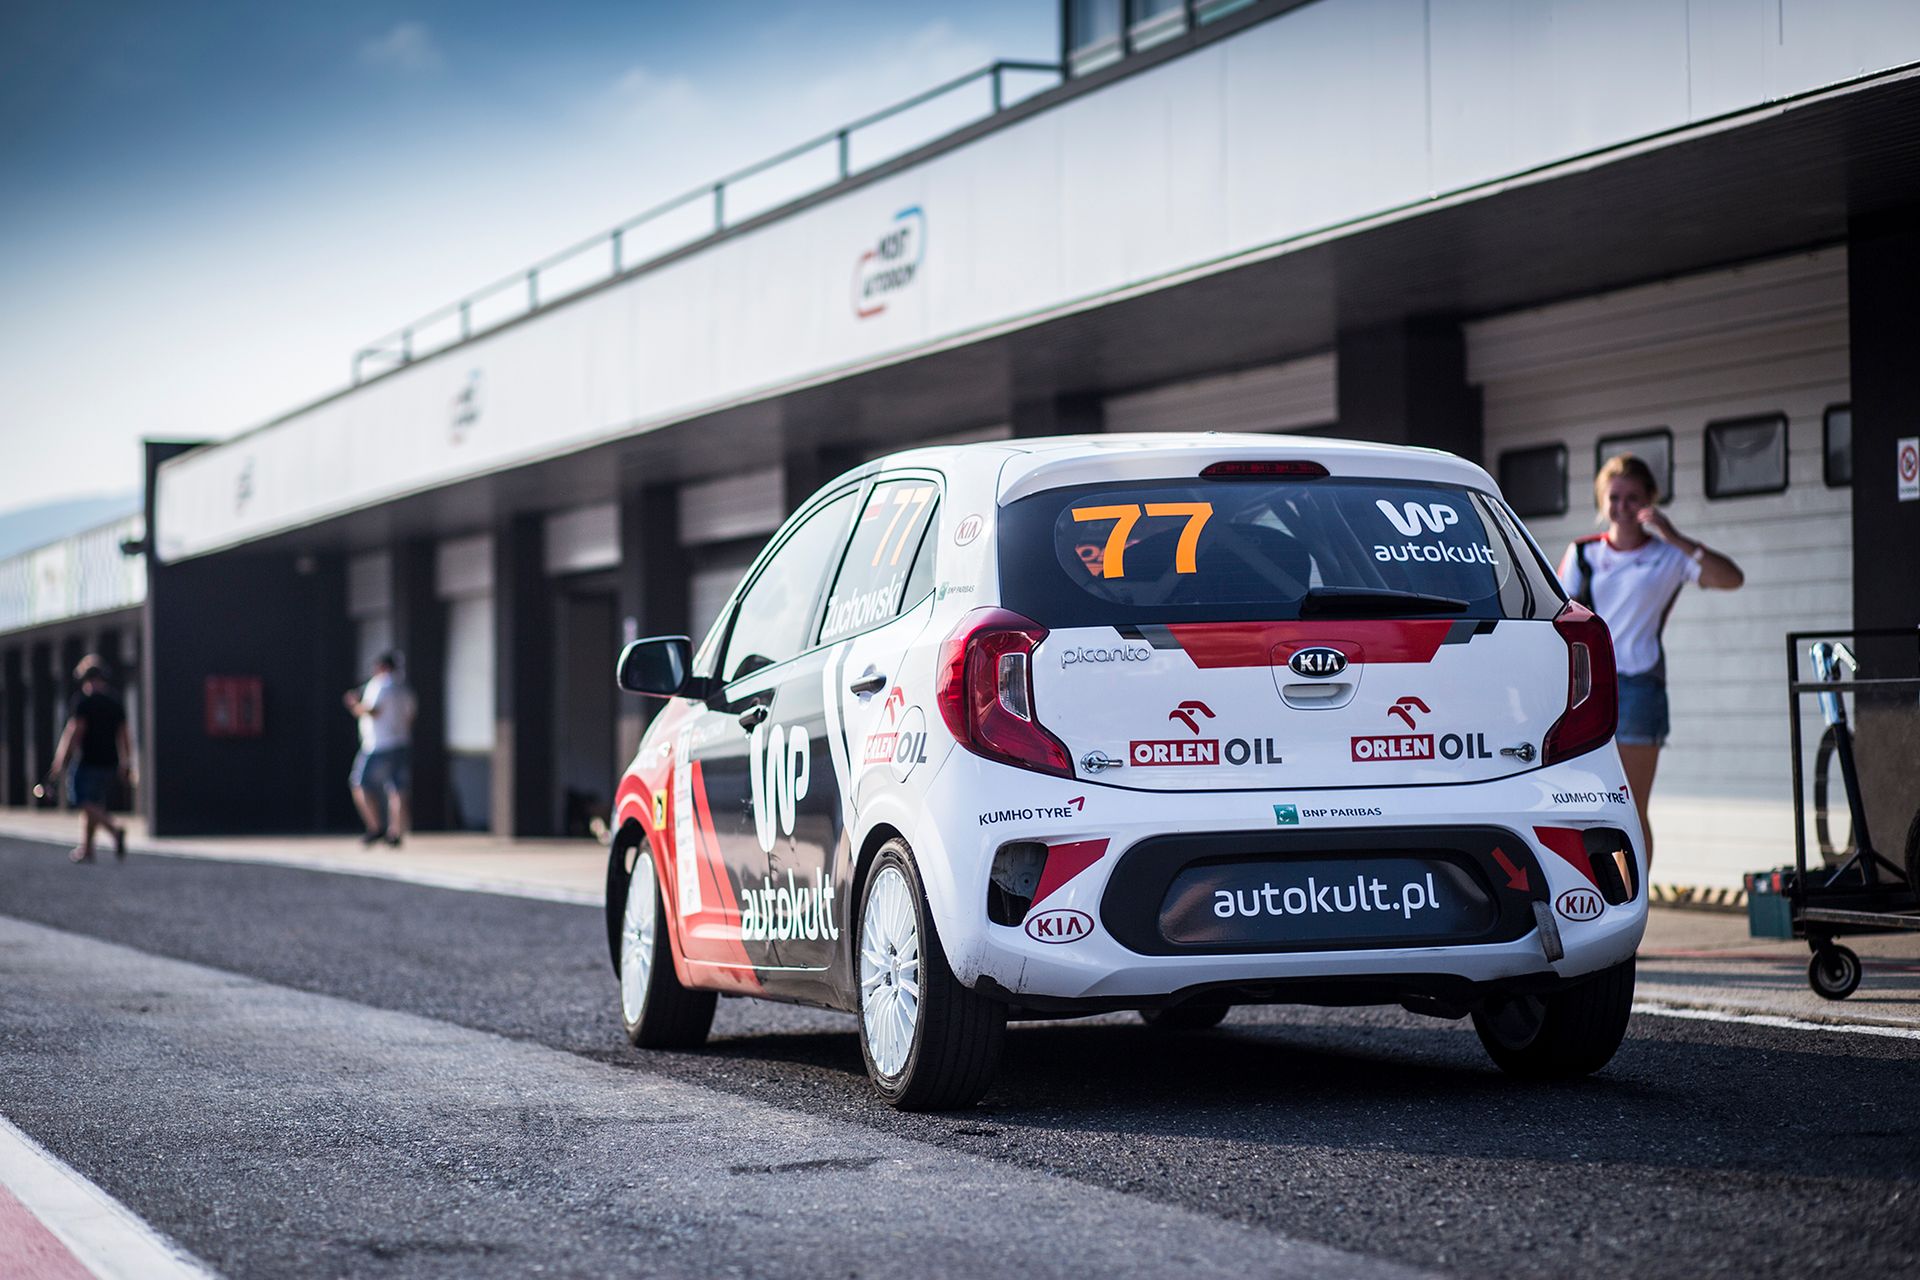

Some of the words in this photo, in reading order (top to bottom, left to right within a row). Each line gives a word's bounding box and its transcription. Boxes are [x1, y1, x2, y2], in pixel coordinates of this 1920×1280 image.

[872, 486, 935, 567] 77
[1375, 500, 1459, 536] WP
[1071, 502, 1214, 579] 77
[1373, 541, 1499, 565] autokult
[1061, 646, 1150, 669] picanto
[1299, 654, 1340, 672] KIA
[897, 731, 928, 764] OIL
[1134, 743, 1215, 763] ORLEN
[1224, 738, 1283, 765] OIL
[1354, 737, 1431, 759] ORLEN
[1439, 733, 1493, 760] OIL
[750, 723, 810, 852] WP
[1551, 792, 1597, 804] KUMHO
[1600, 792, 1626, 805] TYRE
[979, 808, 1033, 826] KUMHO
[1035, 807, 1072, 819] TYRE
[1302, 809, 1327, 818] BNP
[1331, 807, 1382, 817] PARIBAS
[740, 867, 839, 941] autokult
[1213, 873, 1440, 919] autokult.pl
[1565, 895, 1598, 914] KIA
[1037, 916, 1083, 937] KIA
